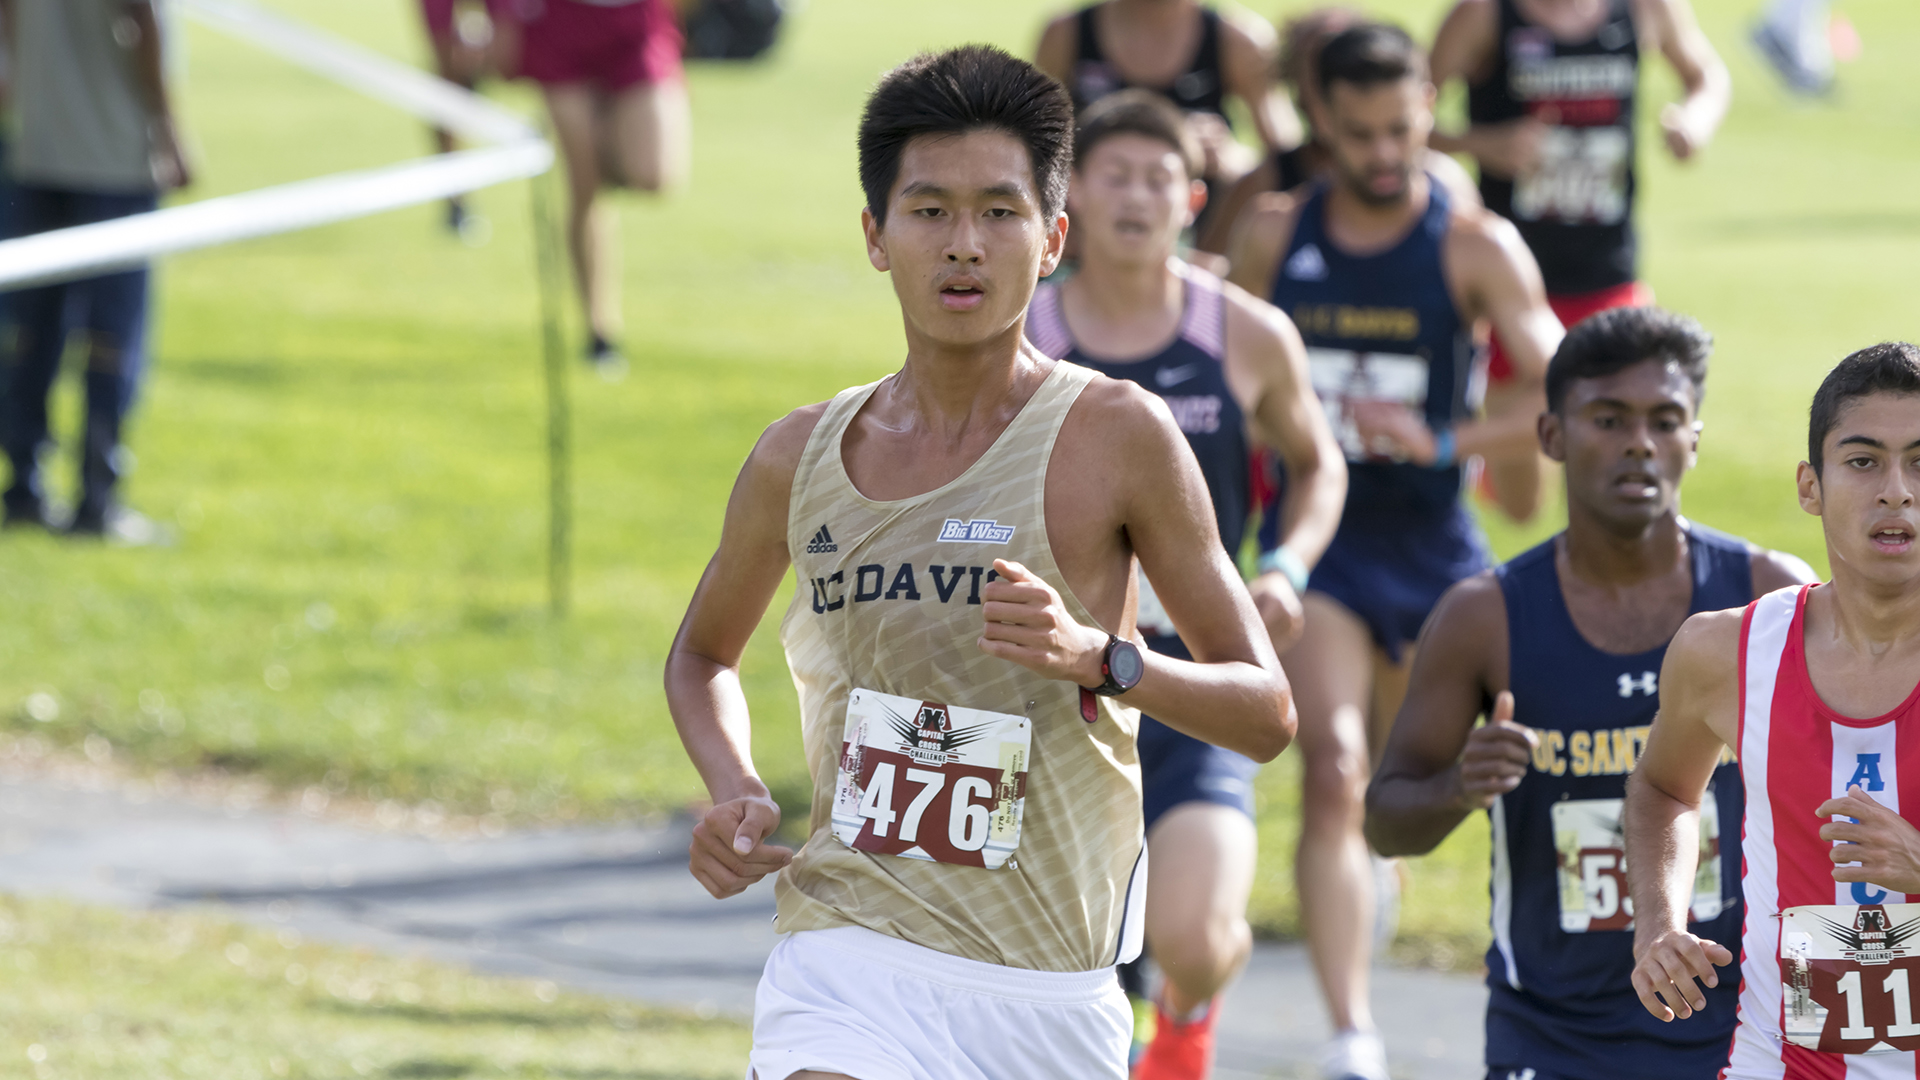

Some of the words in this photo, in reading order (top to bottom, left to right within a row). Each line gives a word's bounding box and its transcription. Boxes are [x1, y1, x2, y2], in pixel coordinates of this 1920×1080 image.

[942, 521, 970, 538] BIG
[970, 521, 1014, 541] WEST
[806, 542, 838, 554] adidas
[811, 570, 844, 614] UC
[917, 729, 945, 741] CAPITAL
[918, 740, 942, 751] CROSS
[1531, 729, 1567, 777] UC
[910, 749, 947, 763] CHALLENGE
[858, 761, 993, 852] 476
[997, 815, 1005, 833] 476
[1582, 853, 1636, 920] 5
[1859, 932, 1887, 940] CAPITAL
[1862, 942, 1886, 950] CROSS
[1855, 951, 1893, 961] CHALLENGE
[1836, 968, 1920, 1040] 11
